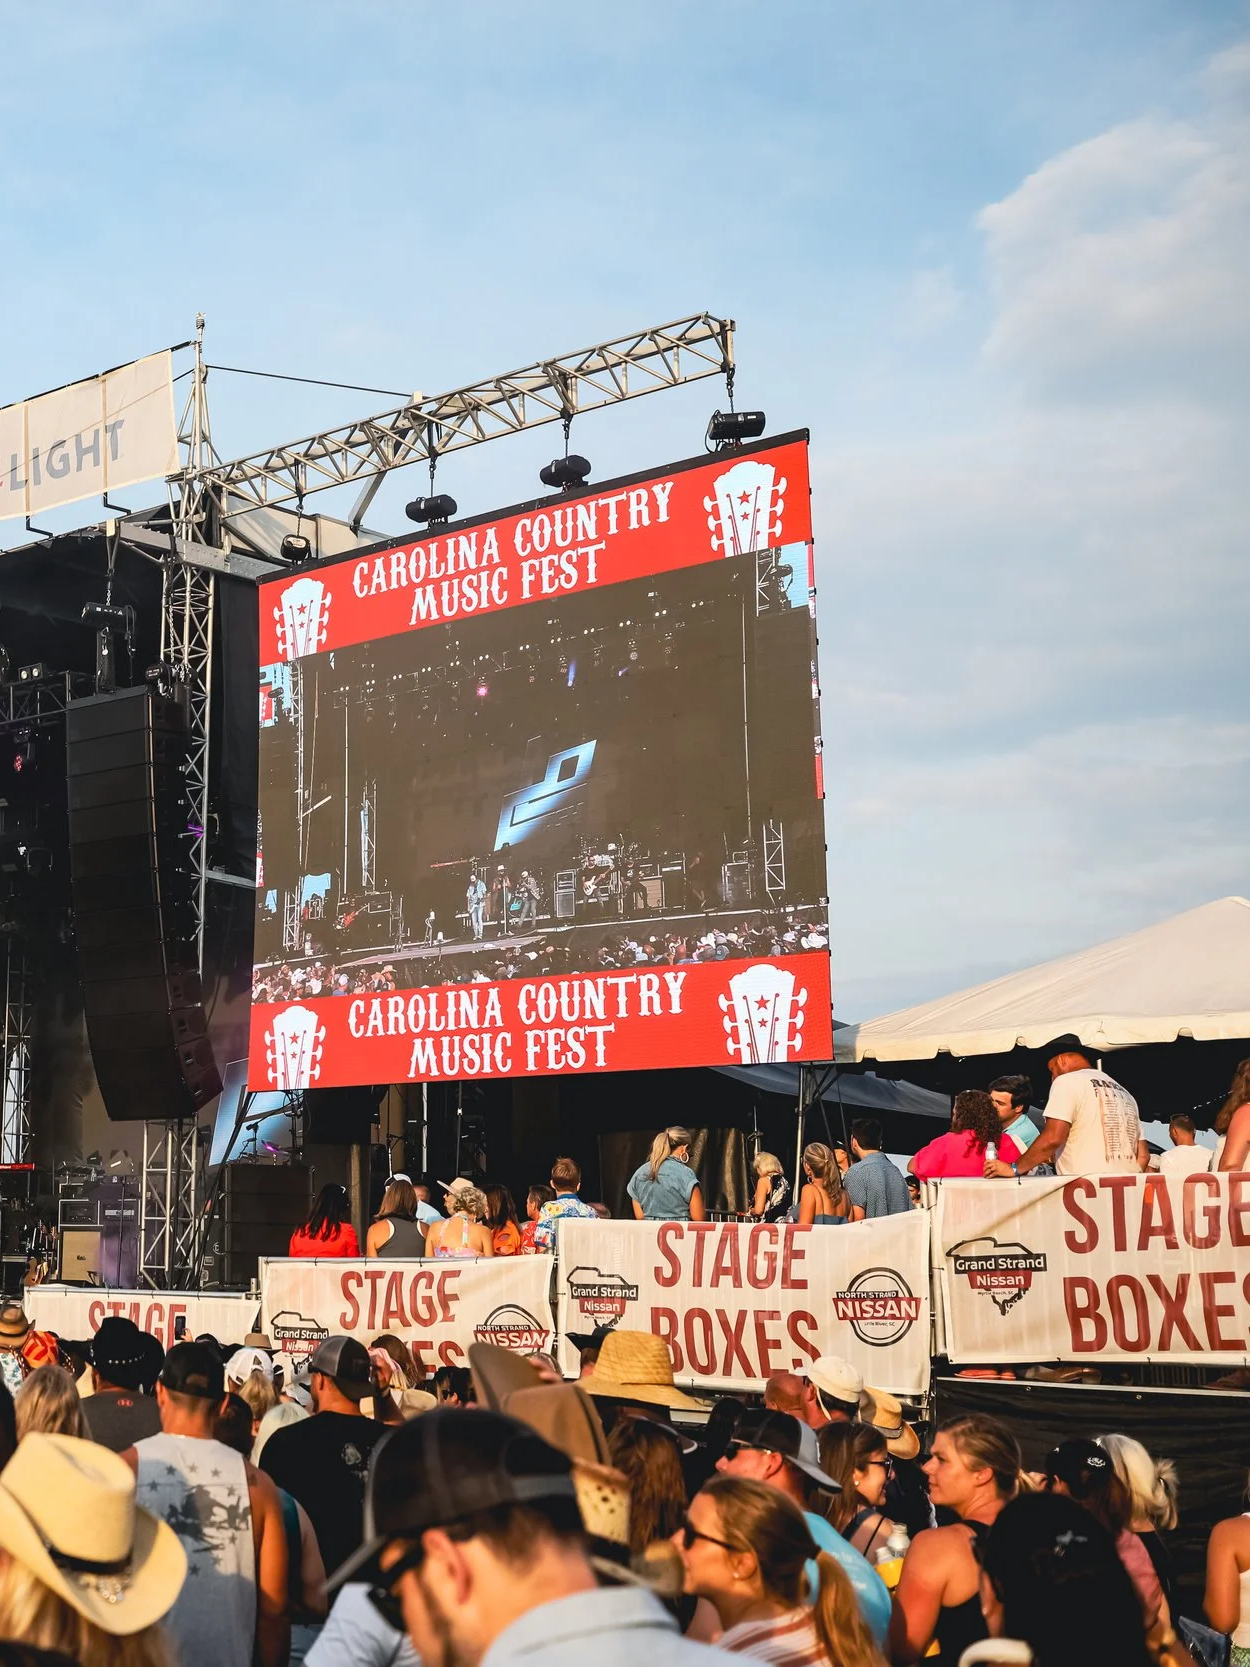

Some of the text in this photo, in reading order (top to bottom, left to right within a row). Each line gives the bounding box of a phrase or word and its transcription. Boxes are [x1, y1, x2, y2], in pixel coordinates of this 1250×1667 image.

[9, 420, 125, 492] LIGHT
[352, 481, 675, 598] CAROLINA COUNTRY
[408, 540, 607, 626] MUSIC FEST
[348, 971, 688, 1040] CAROLINA COUNTRY
[406, 1022, 616, 1079] MUSIC FEST
[1062, 1172, 1250, 1254] STAGE
[654, 1222, 813, 1290] STAGE
[956, 1256, 1045, 1271] Grand Strand
[976, 1274, 1025, 1286] Nissan
[339, 1270, 462, 1331] STAGE
[572, 1286, 637, 1298] Grand Strand
[584, 1300, 620, 1312] Nissan
[837, 1300, 917, 1318] NISSAN
[1063, 1271, 1250, 1353] BOXE
[274, 1328, 328, 1340] Grand Strand
[476, 1332, 546, 1347] NISSAN
[650, 1306, 822, 1379] BOXES
